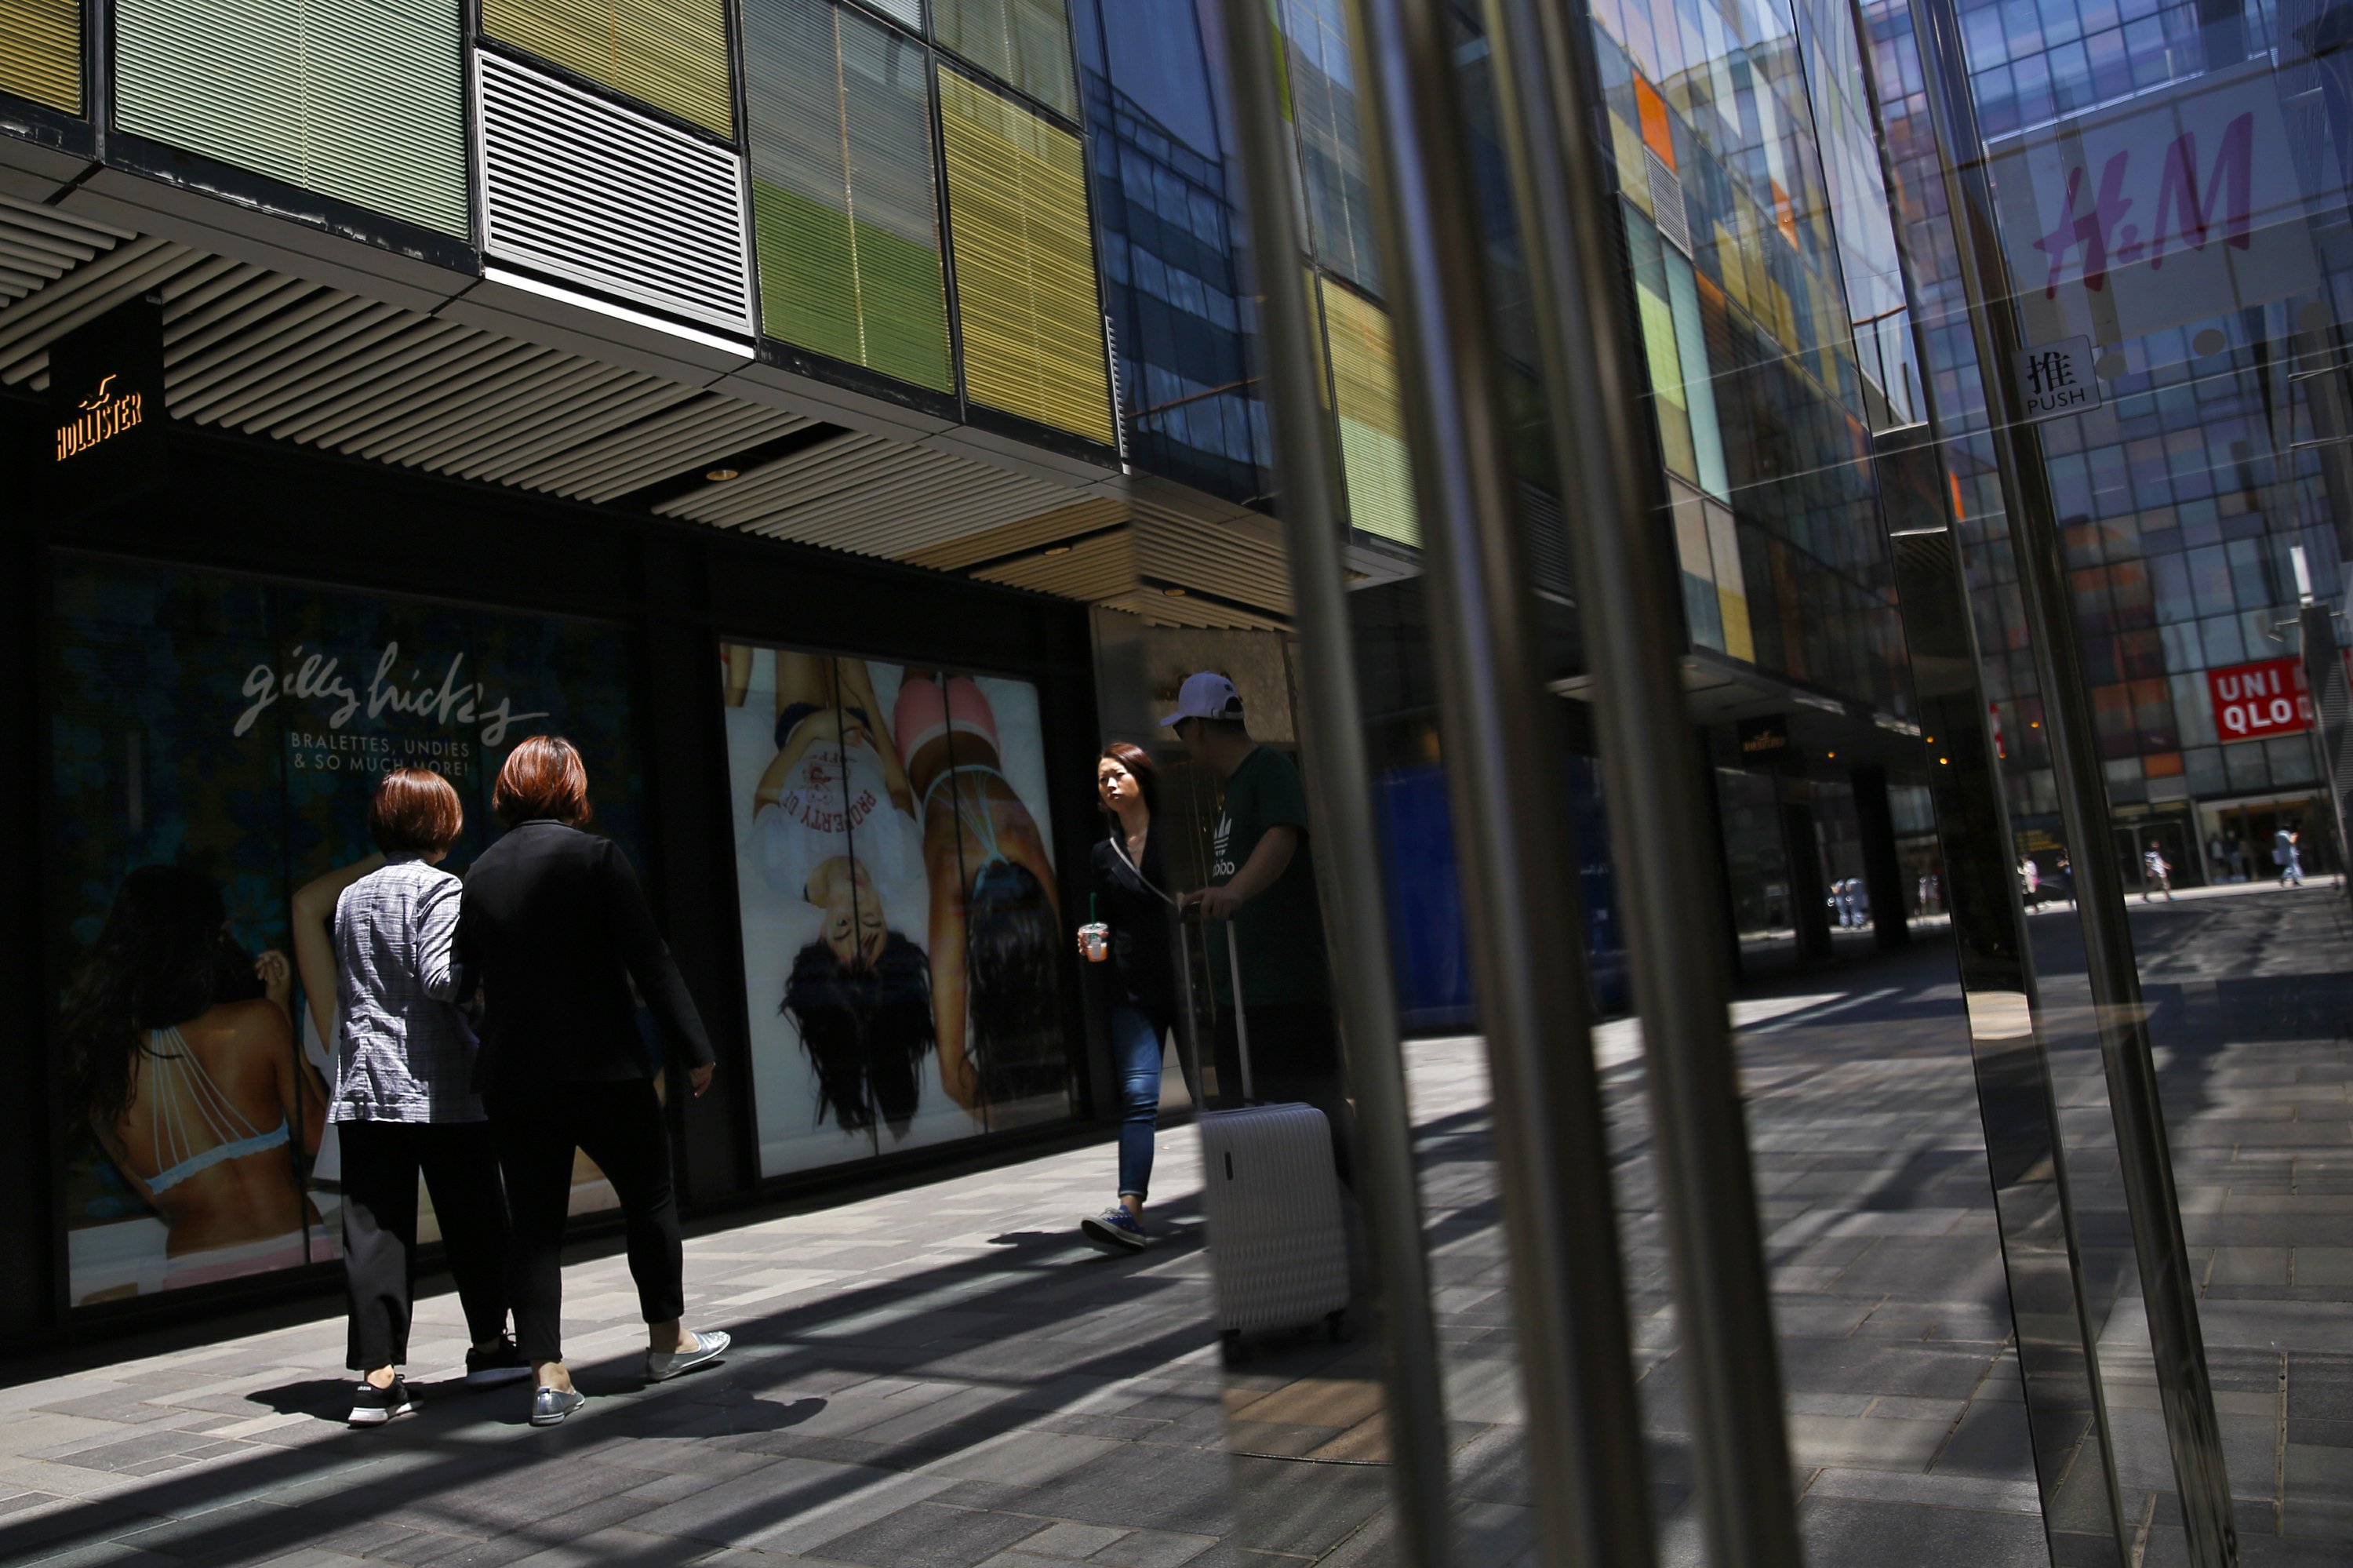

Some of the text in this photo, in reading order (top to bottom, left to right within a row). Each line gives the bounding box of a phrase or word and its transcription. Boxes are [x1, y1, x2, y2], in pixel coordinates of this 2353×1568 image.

[2032, 111, 2253, 300] H&M
[2027, 351, 2078, 395] 推
[2027, 387, 2086, 416] PUSH
[56, 391, 142, 461] HOLLISTER
[234, 645, 361, 737] gilly
[2217, 668, 2282, 702] UNI
[2222, 697, 2294, 735] QLO
[291, 732, 470, 759] BRALETTES, UNDIES
[294, 753, 306, 769] &
[315, 754, 341, 770] SO
[350, 755, 404, 772] MUCH
